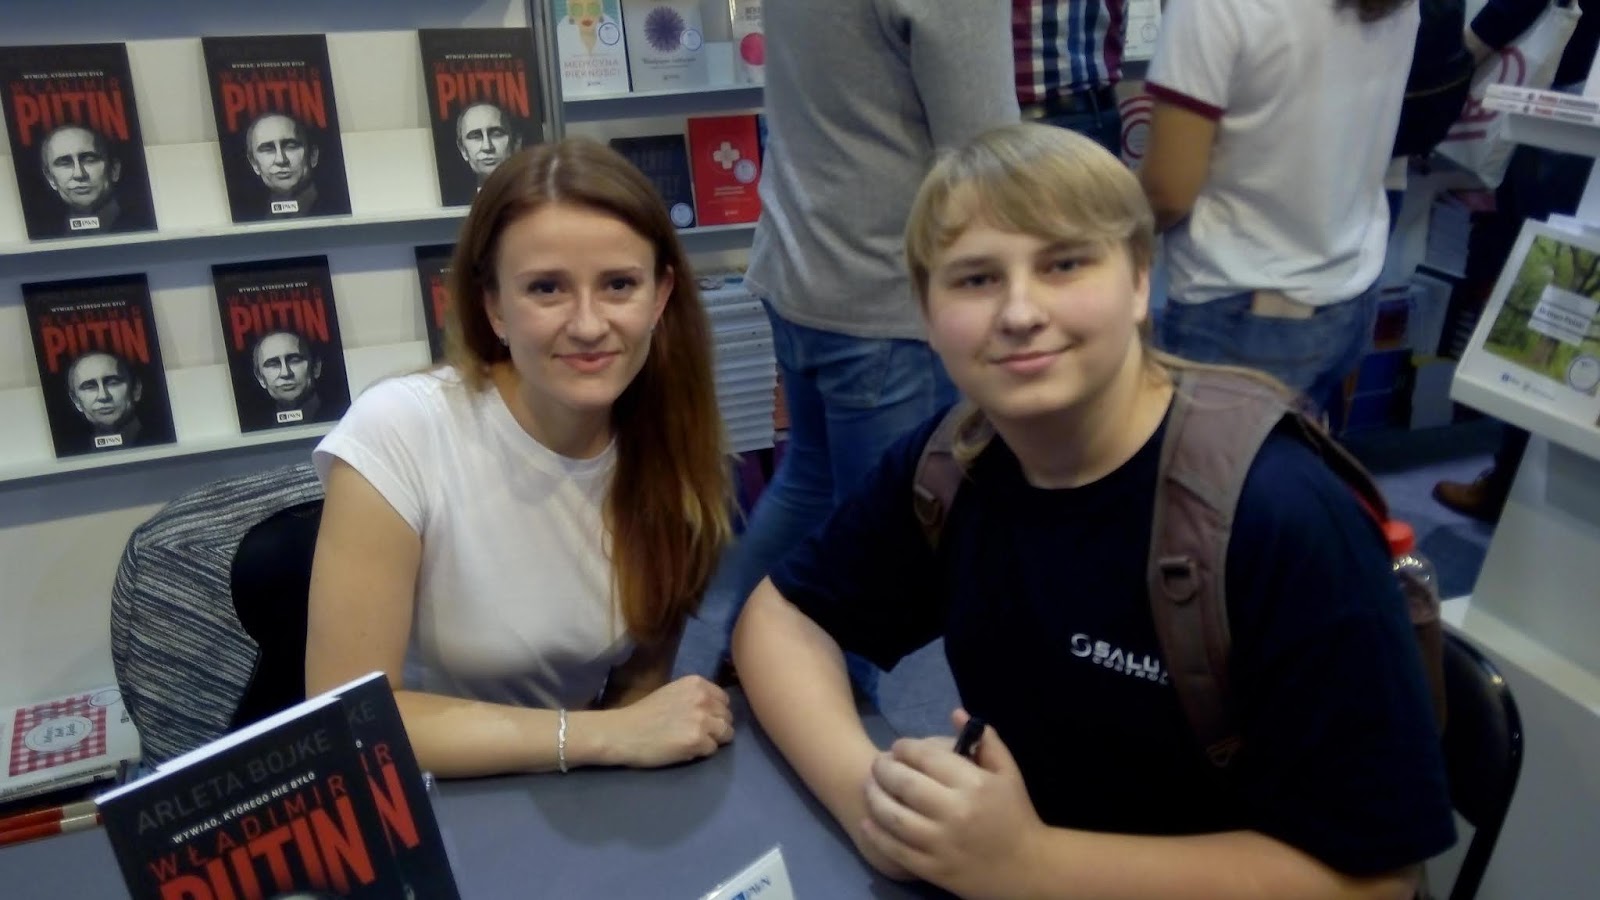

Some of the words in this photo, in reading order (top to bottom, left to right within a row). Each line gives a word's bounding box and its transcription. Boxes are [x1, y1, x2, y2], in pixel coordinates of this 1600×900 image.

[13, 89, 130, 147] PUTIN
[222, 79, 328, 134] PUTIN
[435, 71, 531, 122] PUTIN
[40, 318, 151, 374] PUTIN
[229, 298, 331, 352] PUTIN
[138, 770, 244, 836] ARLETA
[249, 729, 331, 783] BOJKE
[223, 794, 270, 822] KTÓREGO
[271, 784, 290, 799] NIE
[290, 771, 316, 790] BYŁO
[150, 774, 348, 881] WŁADIMIR
